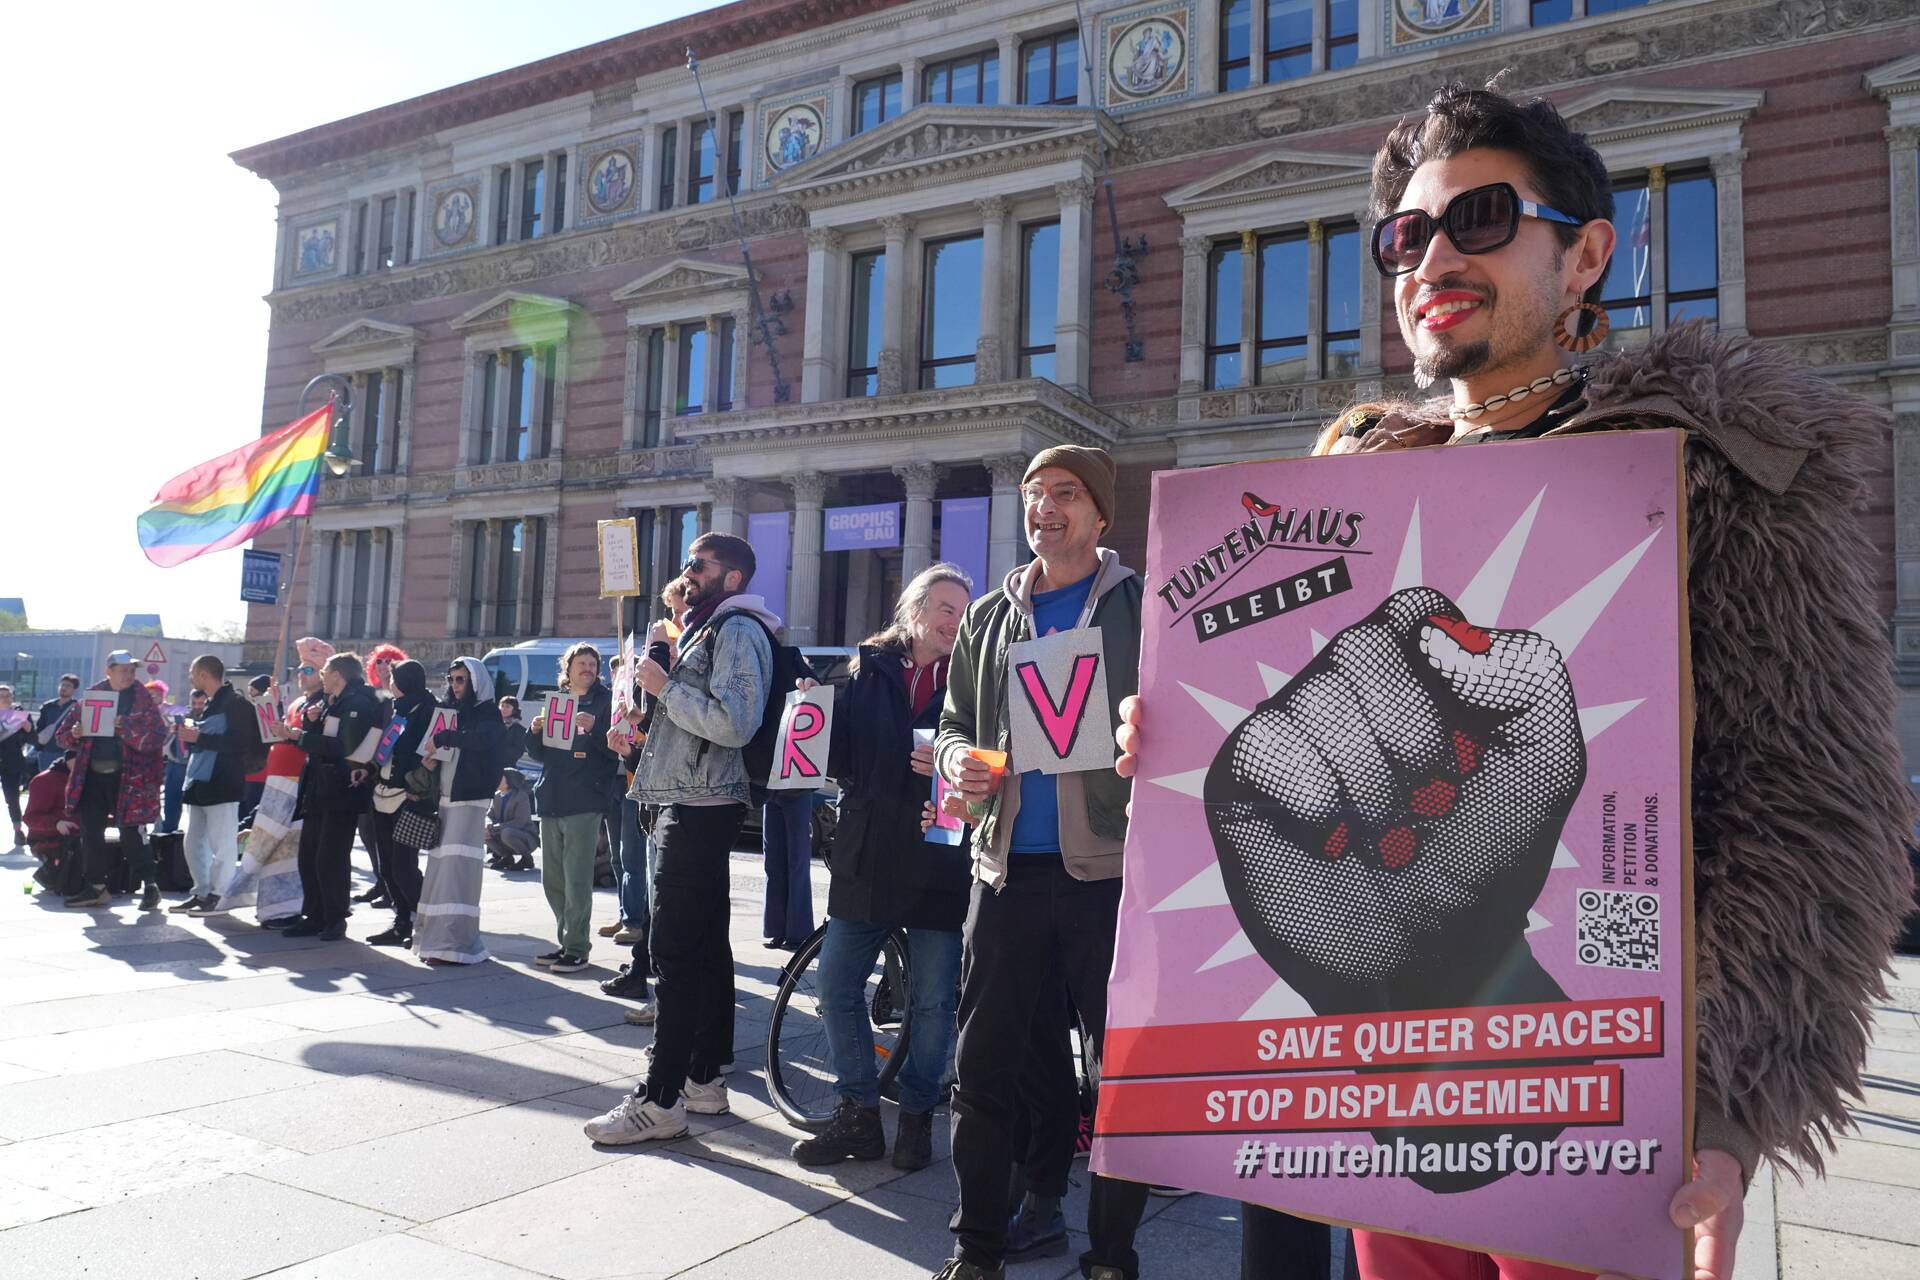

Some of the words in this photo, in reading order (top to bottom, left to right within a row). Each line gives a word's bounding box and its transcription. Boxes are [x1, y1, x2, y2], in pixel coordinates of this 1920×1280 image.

[830, 511, 894, 529] GROPIUS
[864, 527, 894, 540] BAU
[1202, 567, 1336, 634] BLEIBT
[85, 700, 113, 733] T
[547, 697, 573, 740] H
[1015, 653, 1099, 759] V
[780, 701, 825, 779] R
[1602, 791, 1618, 884] INFORMATION,
[1624, 823, 1637, 885] PETITION
[1645, 793, 1658, 872] DONATIONS.
[1257, 1025, 1343, 1061] SAVE
[1354, 1018, 1473, 1062] QUEER
[1487, 1007, 1653, 1050] SPACES!
[1205, 1088, 1293, 1122] STOP
[1304, 1076, 1609, 1120] DISPLACEMENT!
[1233, 1134, 1660, 1177] #tuntenhausforever
